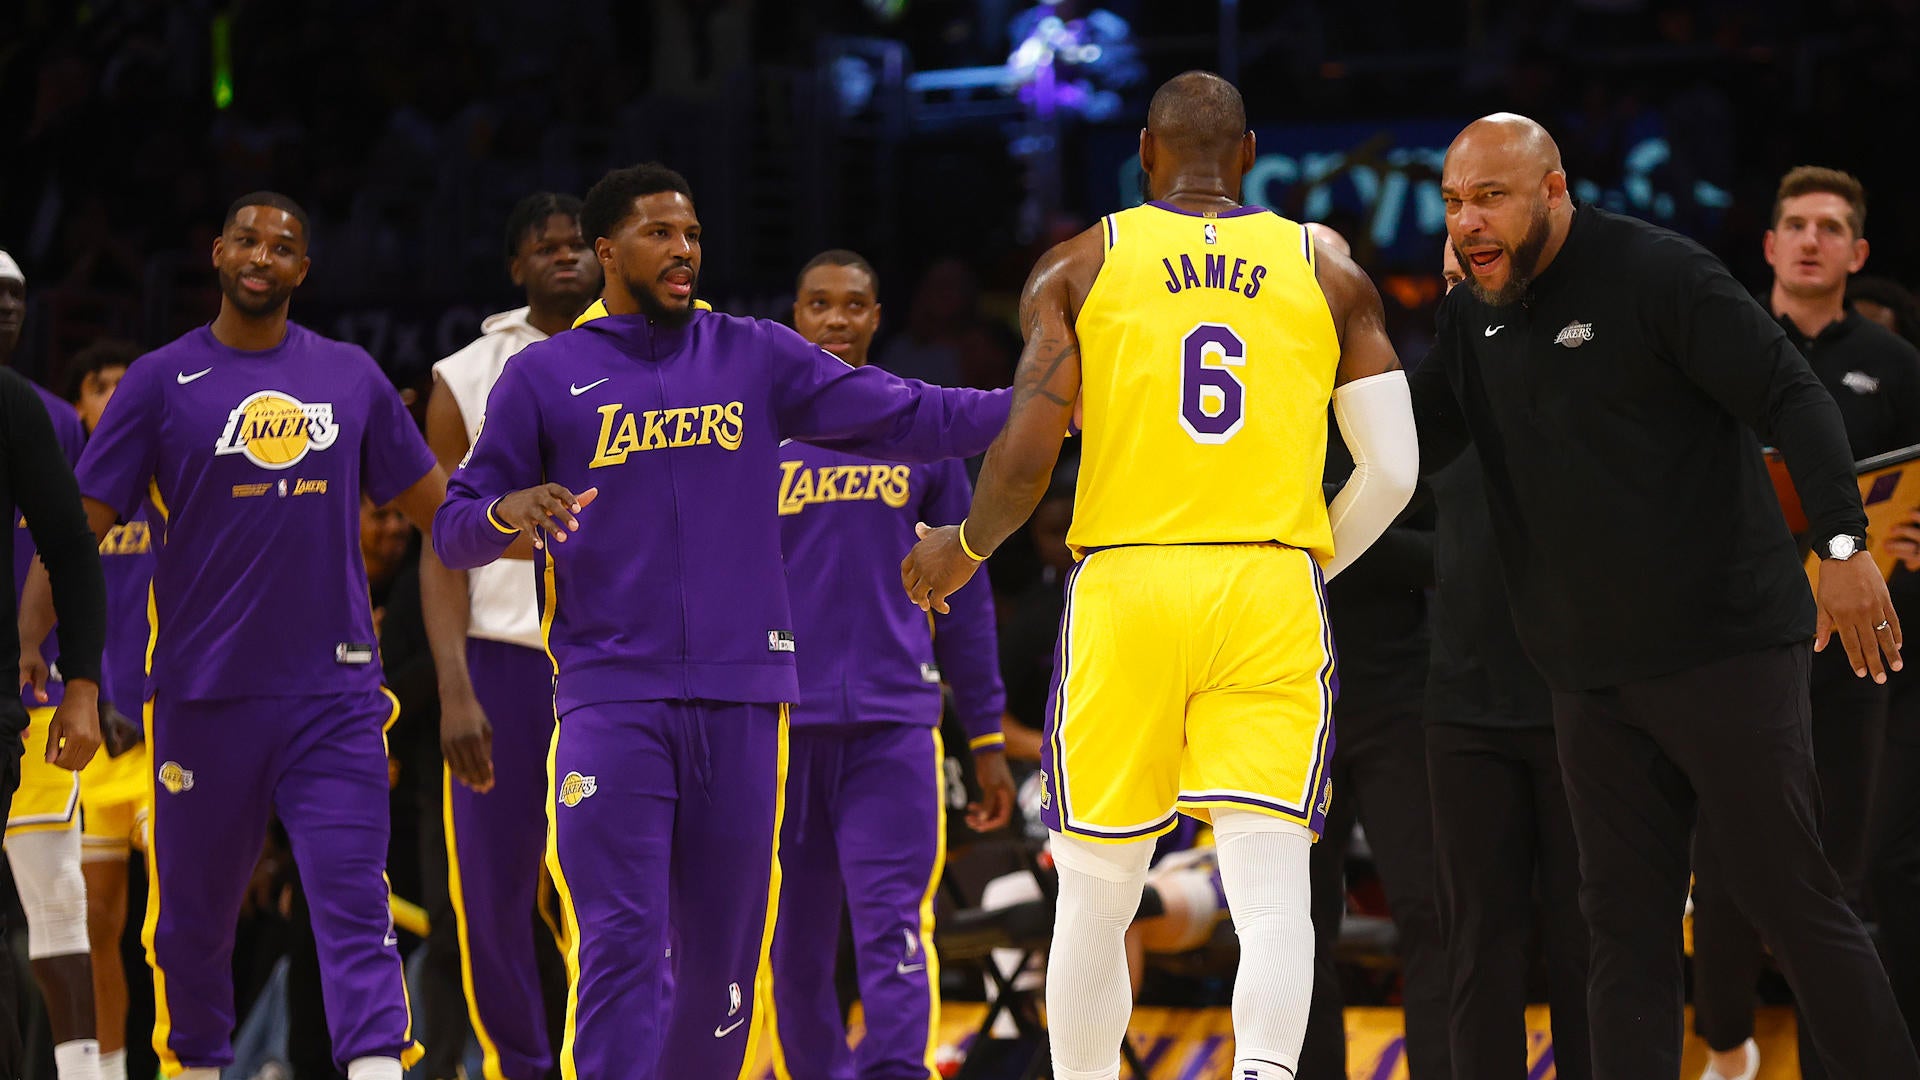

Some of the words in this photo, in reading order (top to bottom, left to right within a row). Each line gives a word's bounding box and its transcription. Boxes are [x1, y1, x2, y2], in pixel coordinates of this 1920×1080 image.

[1162, 253, 1267, 299] JAMES
[1553, 327, 1595, 345] LAKERS
[1179, 322, 1246, 444] 6
[214, 409, 340, 455] LAKERS
[588, 401, 744, 469] LAKERS
[778, 460, 911, 516] LAKERS
